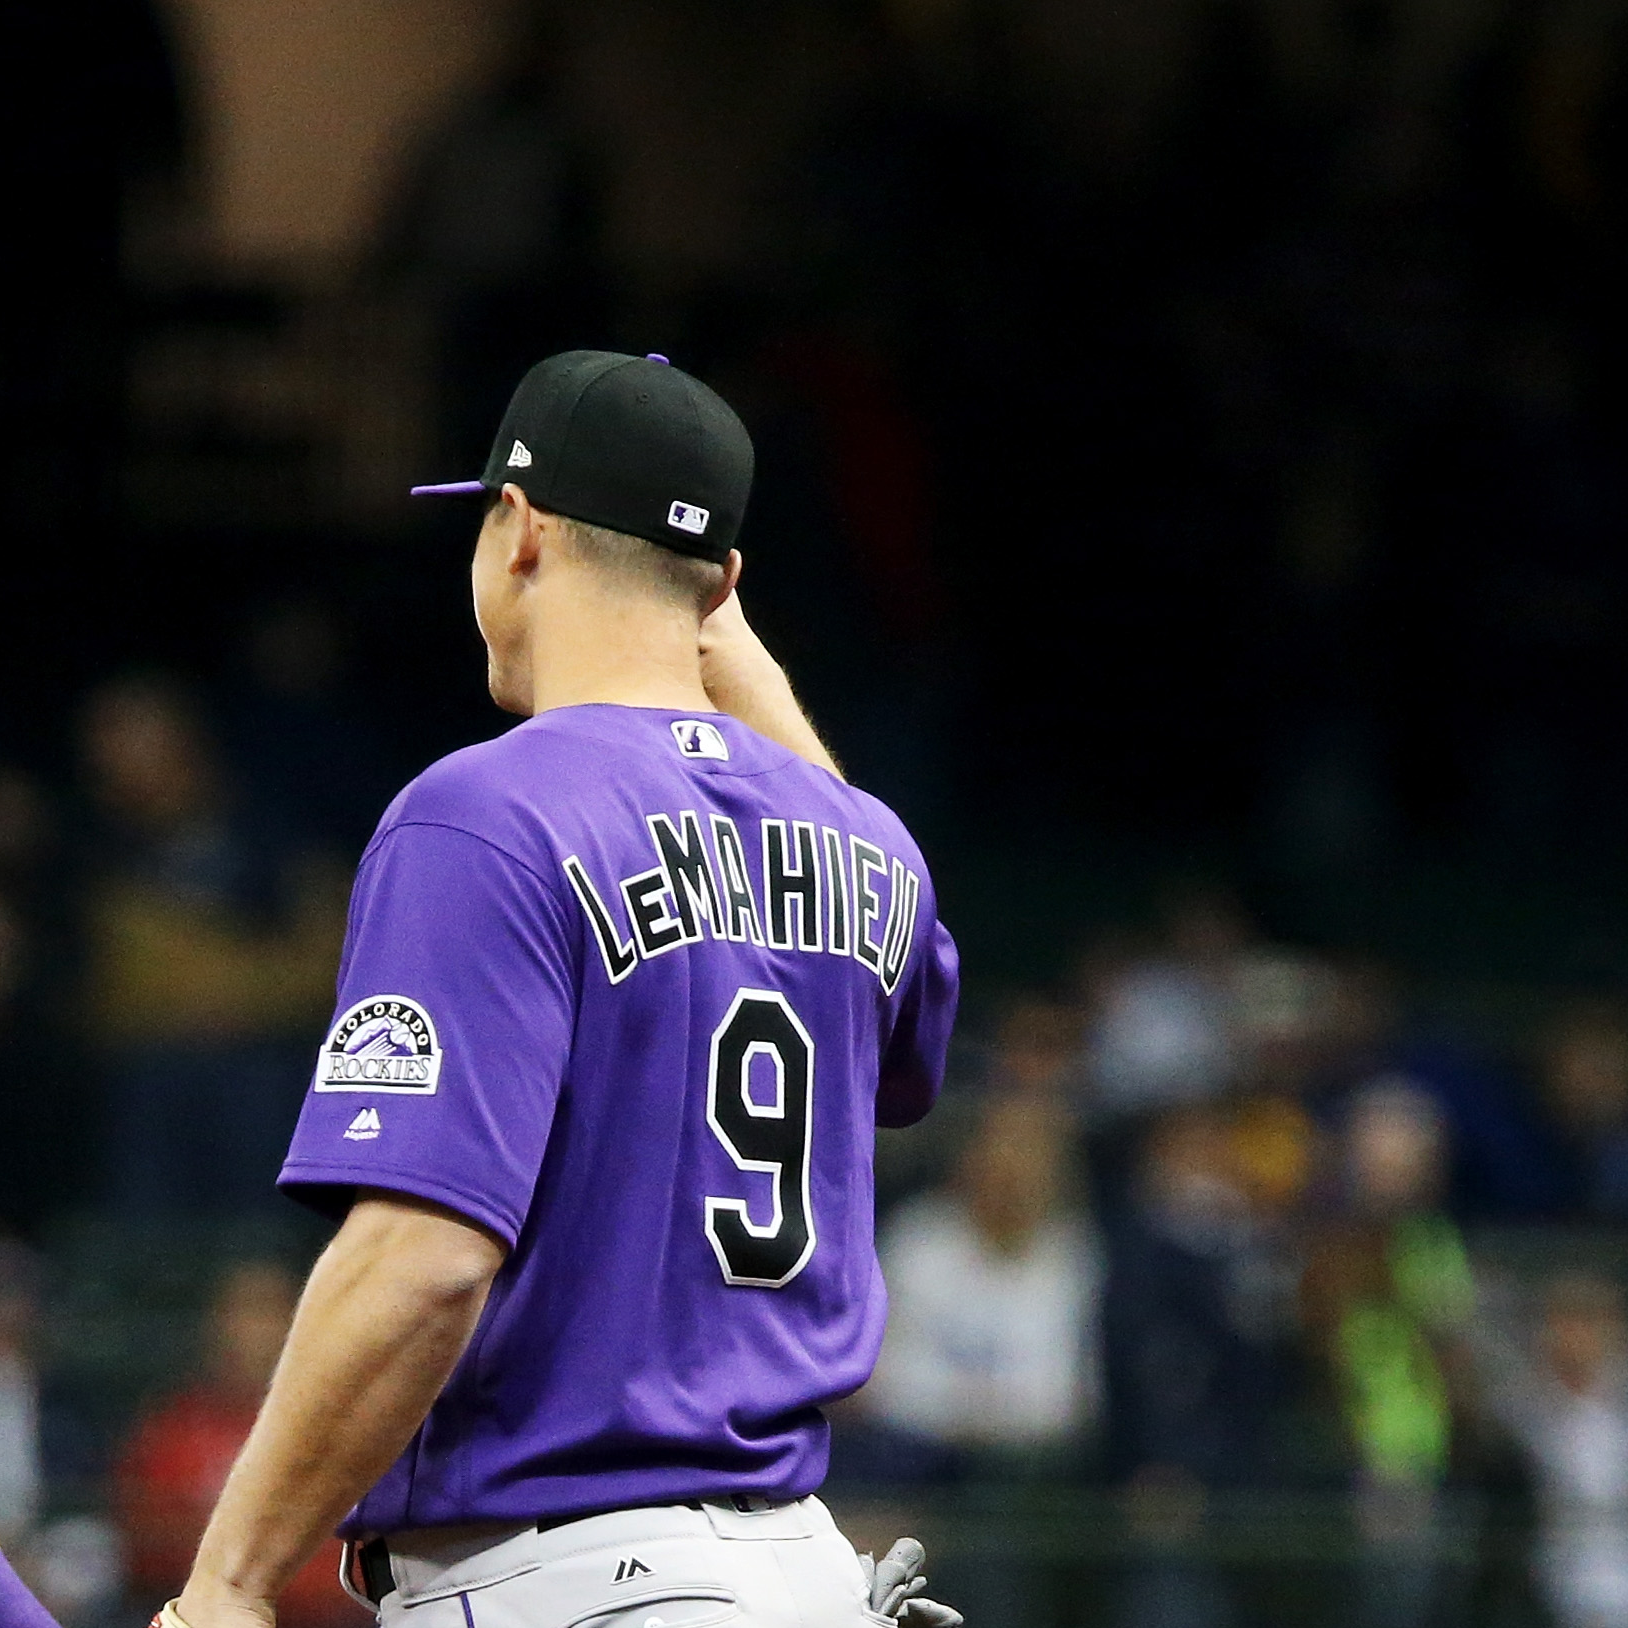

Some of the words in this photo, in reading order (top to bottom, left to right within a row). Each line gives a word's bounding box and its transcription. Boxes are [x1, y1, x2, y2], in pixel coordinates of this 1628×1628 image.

[562, 810, 919, 996] LeMAHIEU
[327, 1055, 431, 1081] ROCKIES
[335, 1002, 430, 1046] COLORADO
[705, 987, 817, 1288] 9
